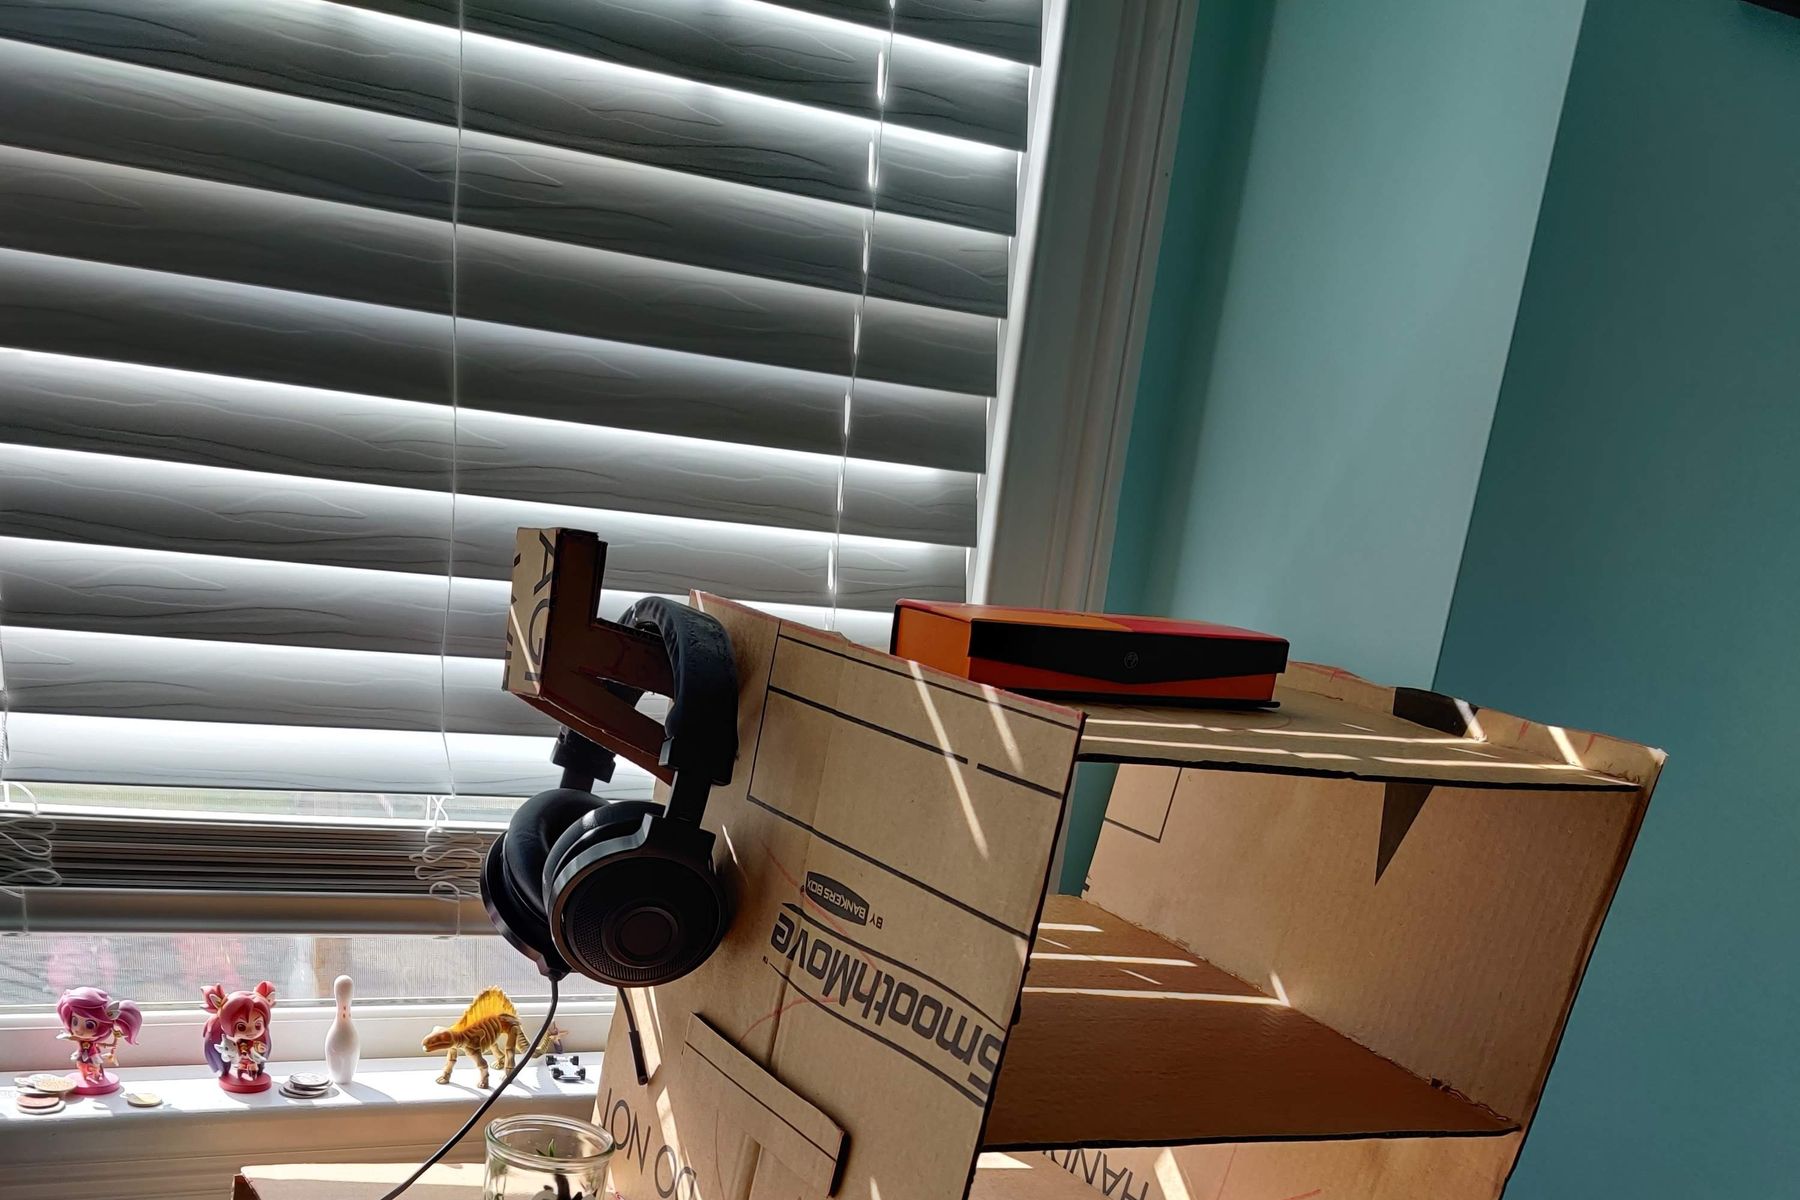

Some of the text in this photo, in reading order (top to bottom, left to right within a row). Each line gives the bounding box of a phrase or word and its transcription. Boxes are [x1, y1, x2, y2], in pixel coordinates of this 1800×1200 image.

[806, 877, 883, 930] BY BANKERS BOX
